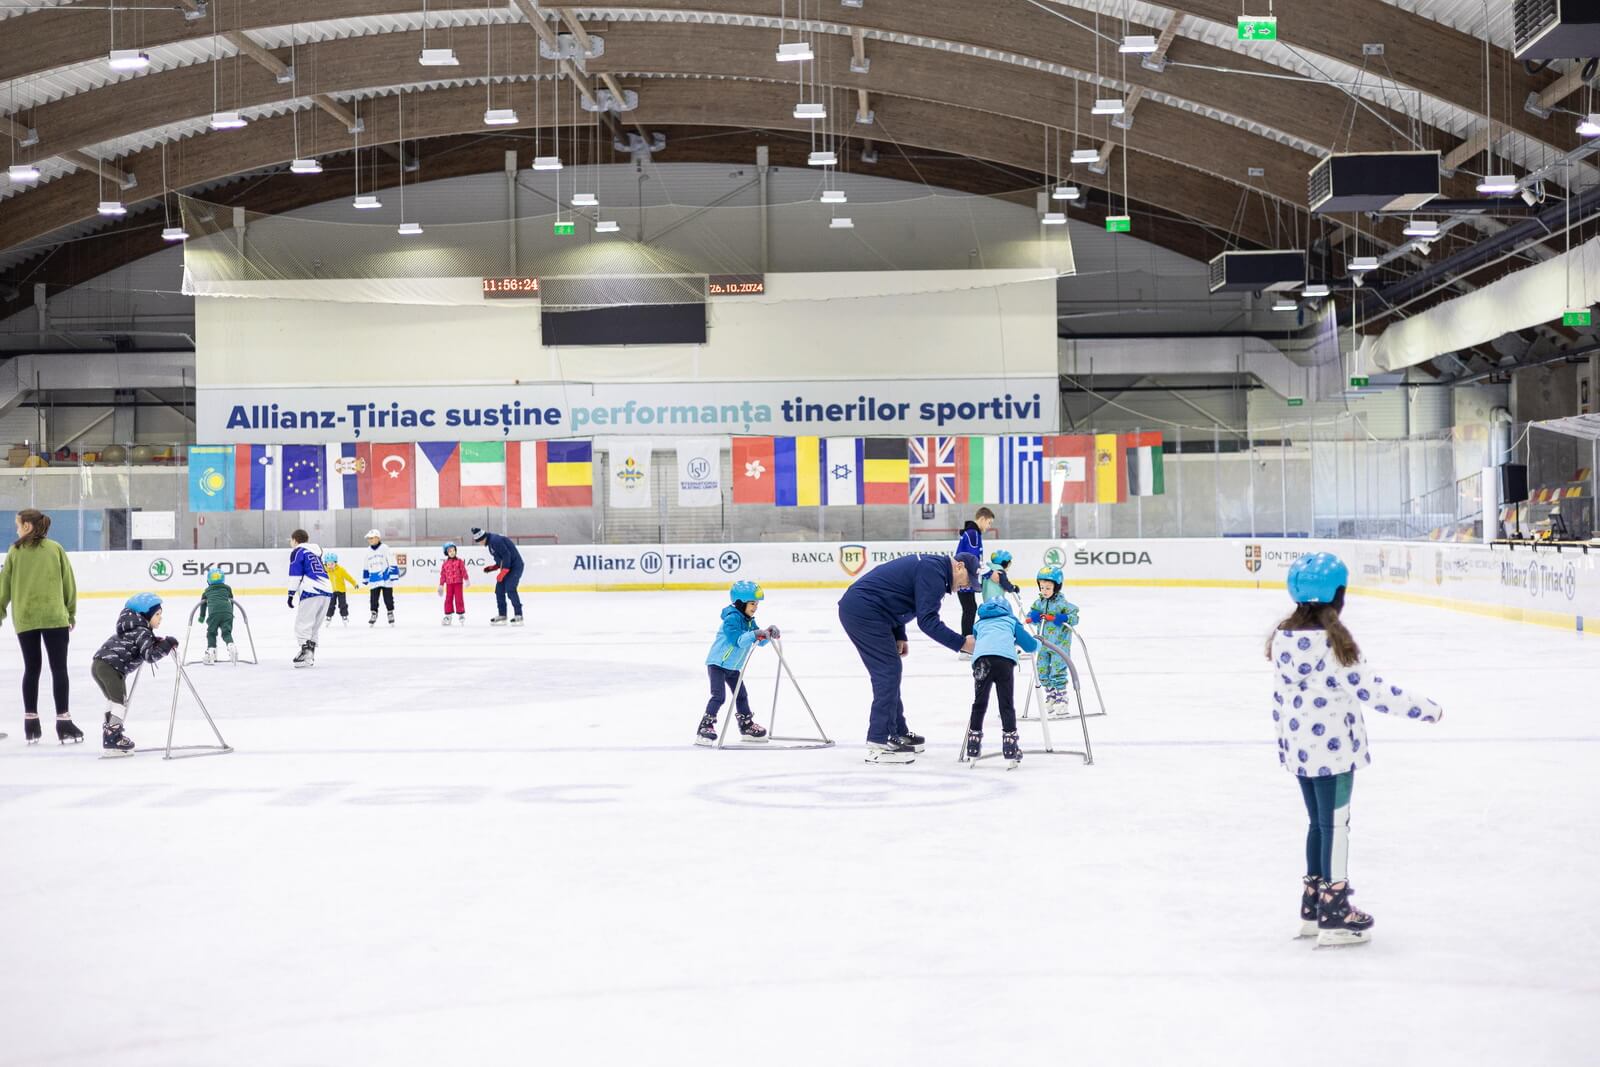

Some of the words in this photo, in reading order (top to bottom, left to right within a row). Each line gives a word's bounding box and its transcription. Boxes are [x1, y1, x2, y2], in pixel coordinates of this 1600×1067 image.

[483, 279, 538, 291] 11:56:24
[709, 283, 763, 293] 26.10.2024
[226, 402, 436, 438] Allianz-Țiriac
[445, 401, 561, 435] susține
[571, 400, 771, 433] performanța
[781, 396, 910, 422] tinerilor
[919, 394, 1041, 426] sportivi
[792, 552, 834, 563] BANCA
[845, 552, 861, 562] BT
[1074, 548, 1152, 565] ŠKODA
[1264, 551, 1282, 560] ION
[182, 560, 270, 576] ŠKODA
[412, 559, 437, 567] ION
[573, 554, 636, 570] Allianz
[666, 554, 715, 574] Țiriac
